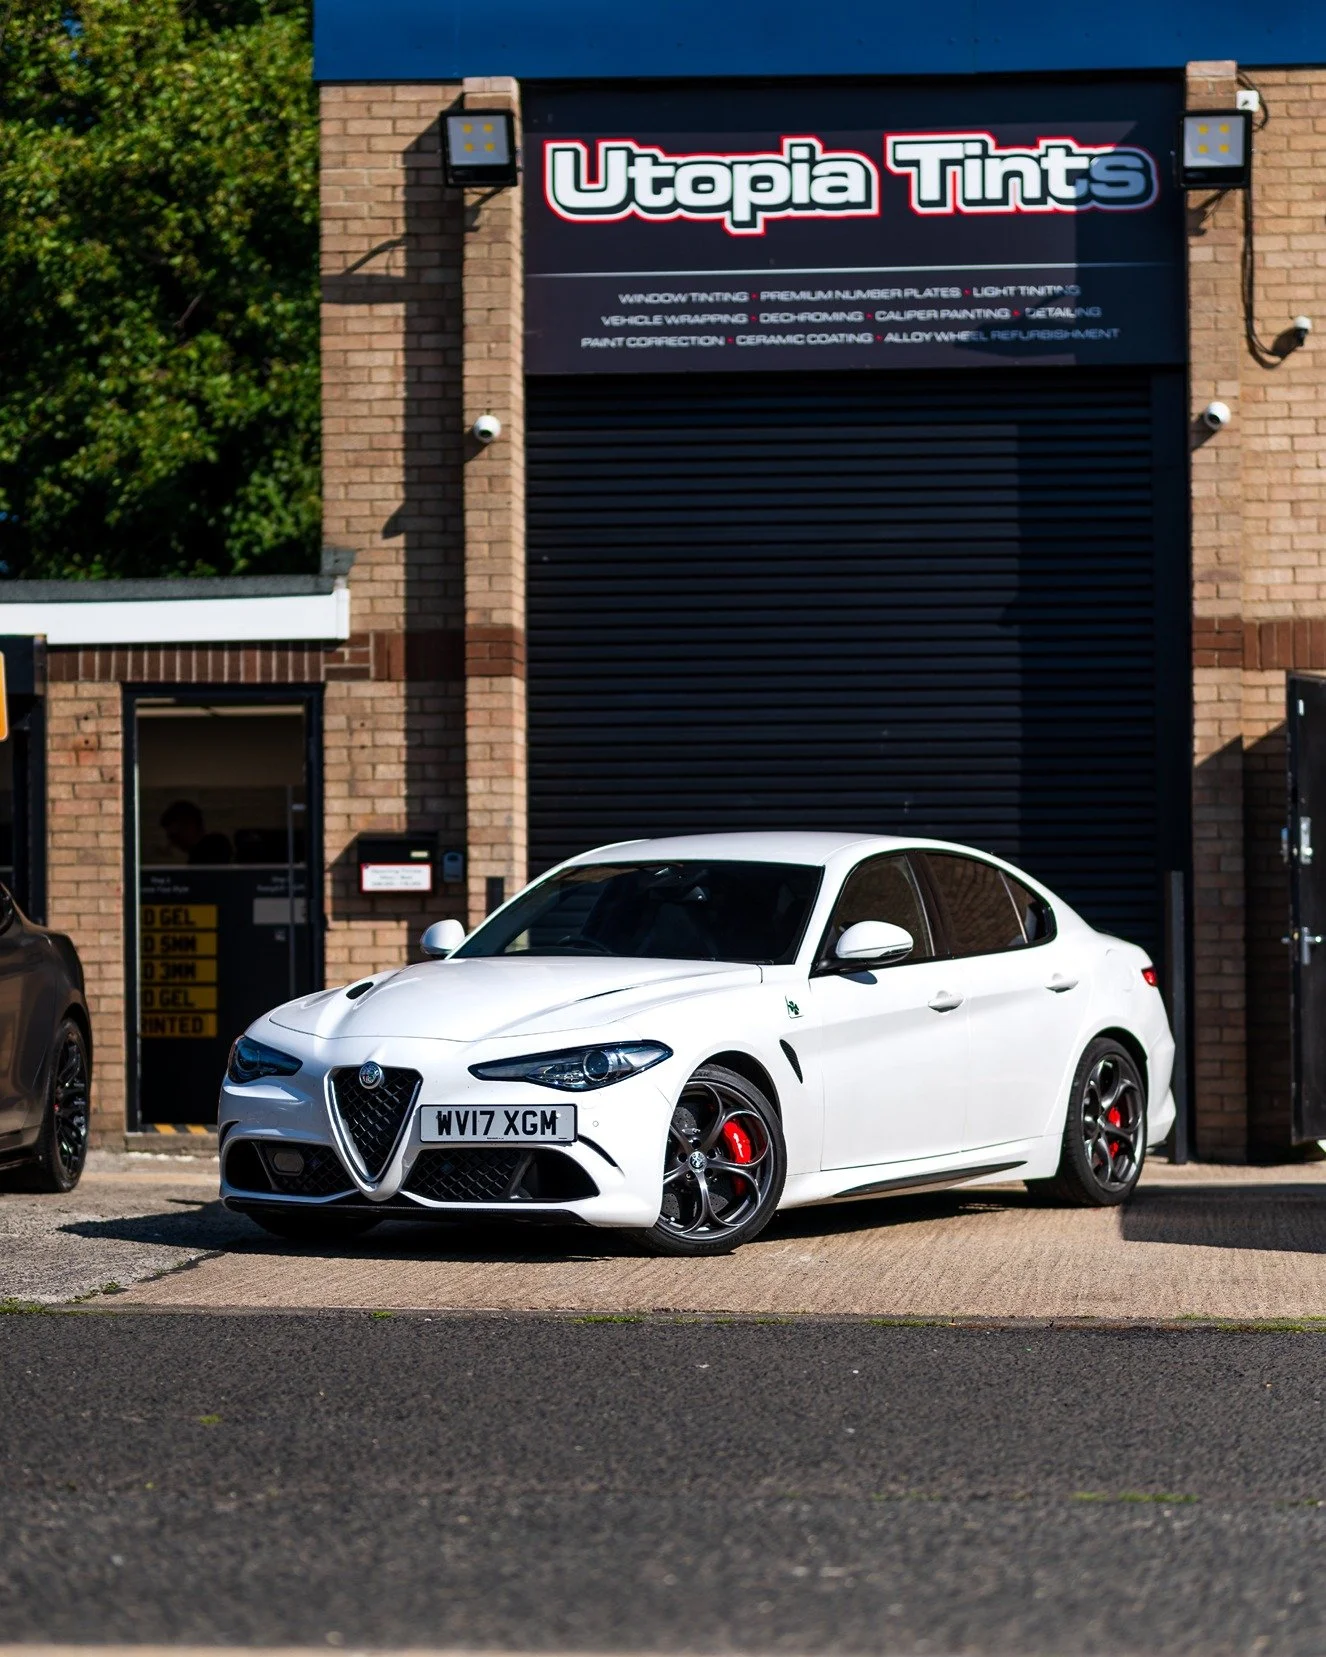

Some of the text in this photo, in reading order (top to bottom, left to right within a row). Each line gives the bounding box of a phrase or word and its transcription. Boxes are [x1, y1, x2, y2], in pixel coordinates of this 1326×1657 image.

[546, 133, 1157, 233] Utopia Tints
[618, 292, 687, 305] WINDOW
[687, 291, 749, 303] TINTING
[760, 289, 832, 302] PREMIUM
[834, 288, 902, 301] NUMBER
[903, 286, 962, 299] PLATES
[972, 285, 1011, 298] LIGHT
[600, 306, 1102, 327] VEHICLE WRAPPING DECHROMING CALIPER PAINTING DETAILING
[581, 328, 1120, 349] PAINT CORRECTION CERAMIC COATING ALLOY WHEEL REFURBISHMENT
[159, 907, 195, 926] GEL
[159, 988, 194, 1008] GEL
[436, 1110, 557, 1136] WV17 XGM
